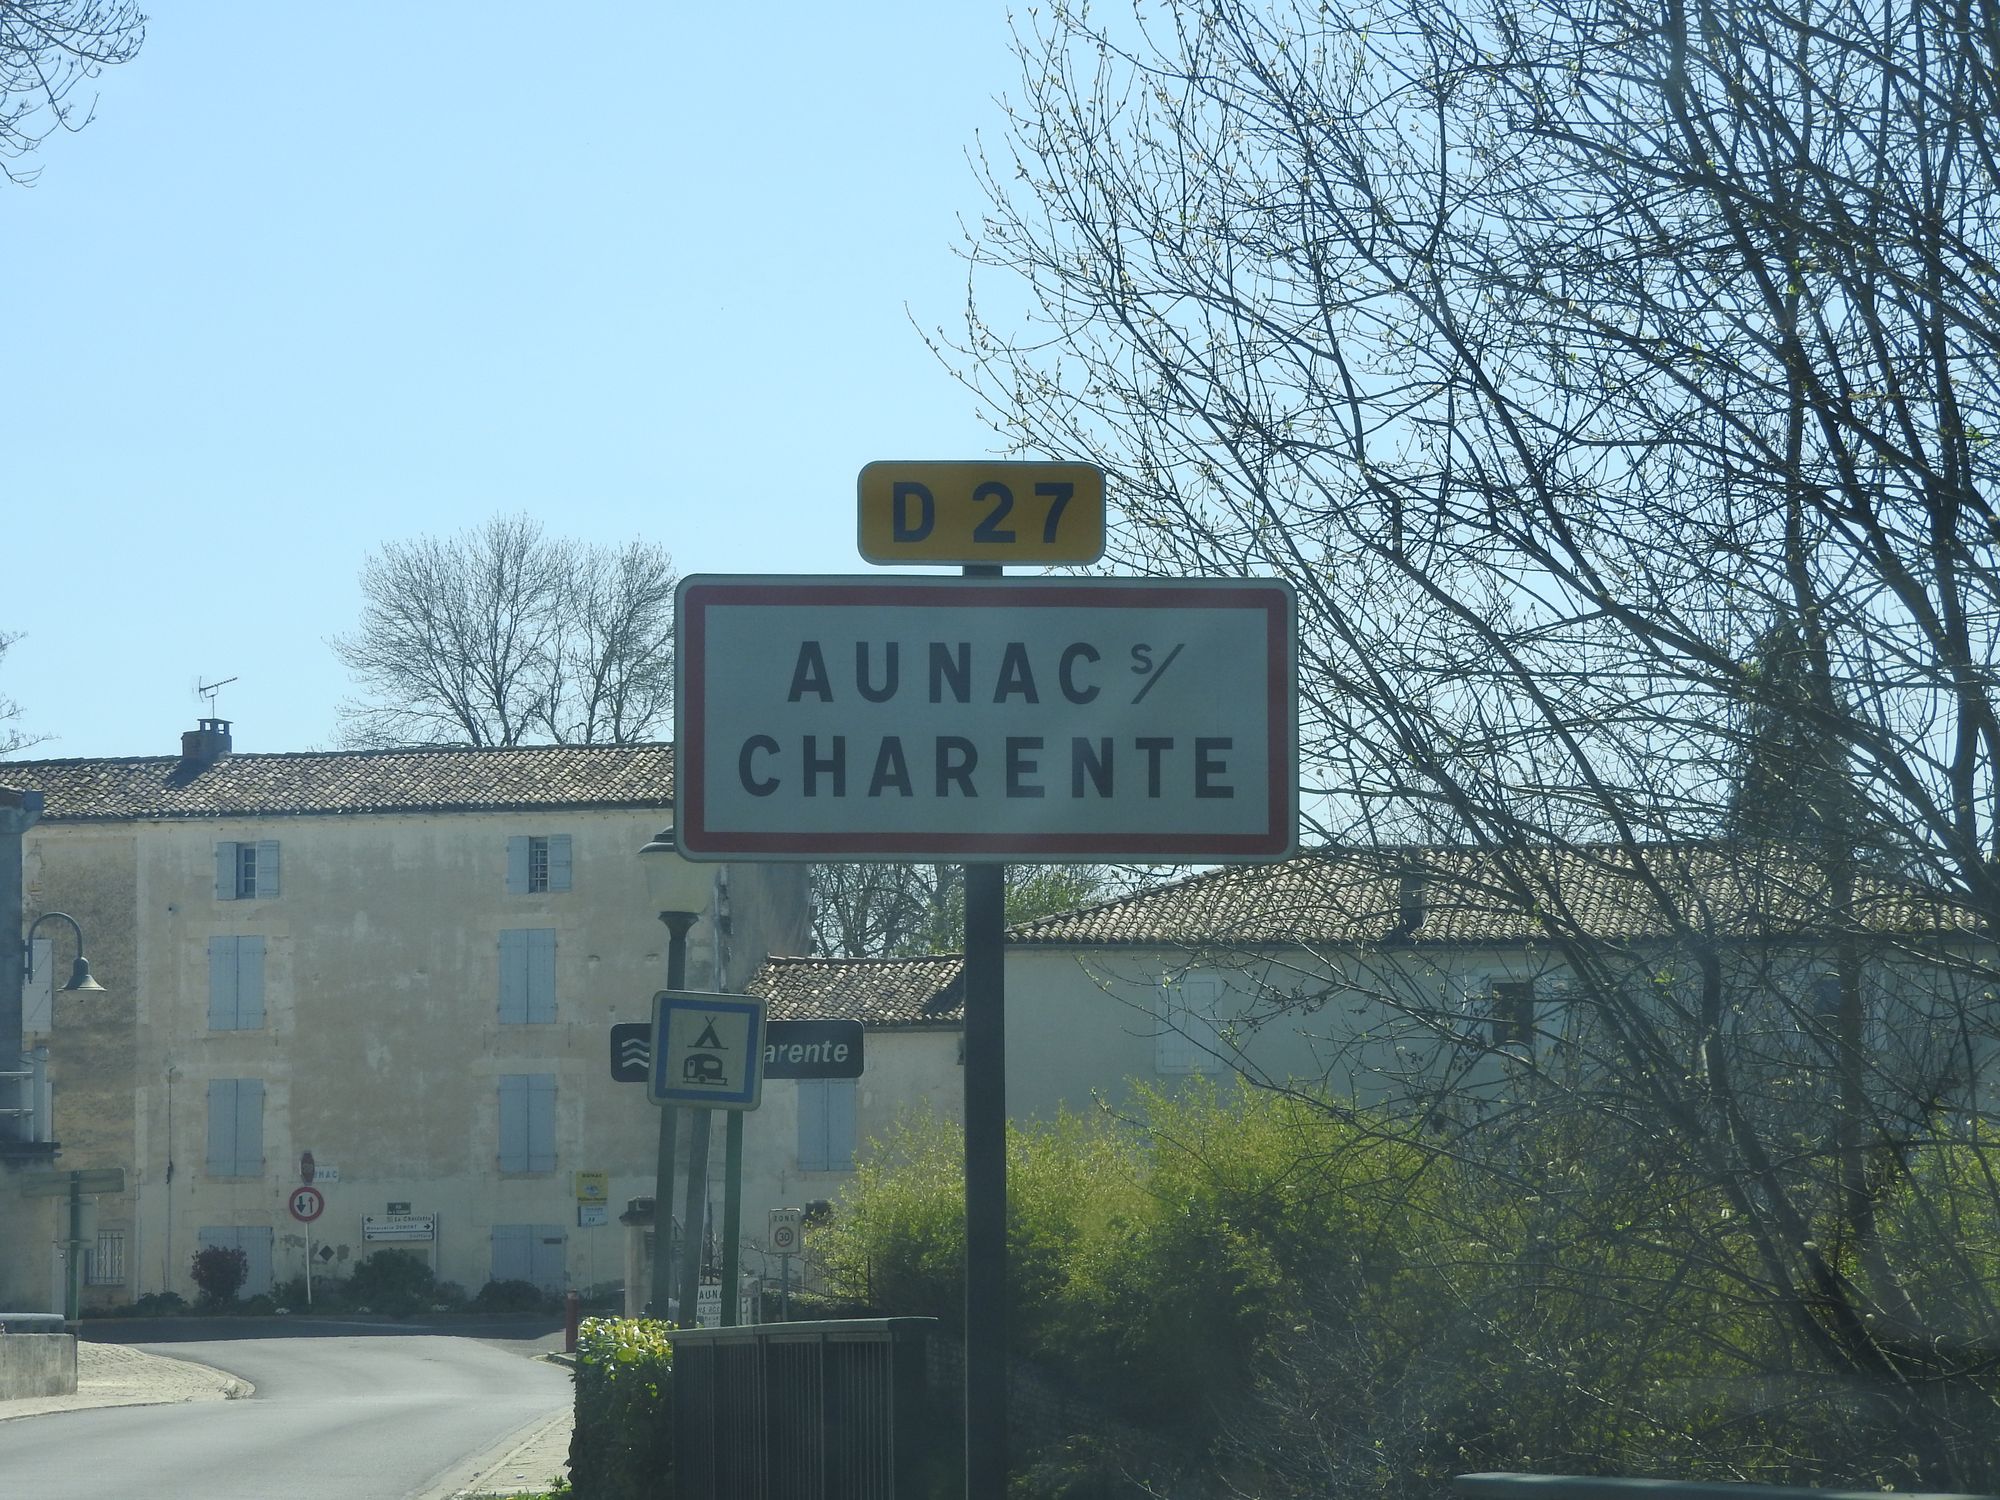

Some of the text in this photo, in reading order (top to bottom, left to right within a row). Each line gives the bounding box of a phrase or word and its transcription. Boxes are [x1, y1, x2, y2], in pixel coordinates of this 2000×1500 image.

[892, 481, 1075, 544] D 27
[786, 641, 1101, 704] AUNAC
[737, 734, 1235, 799] CHARENTE
[779, 1232, 790, 1242] 30
